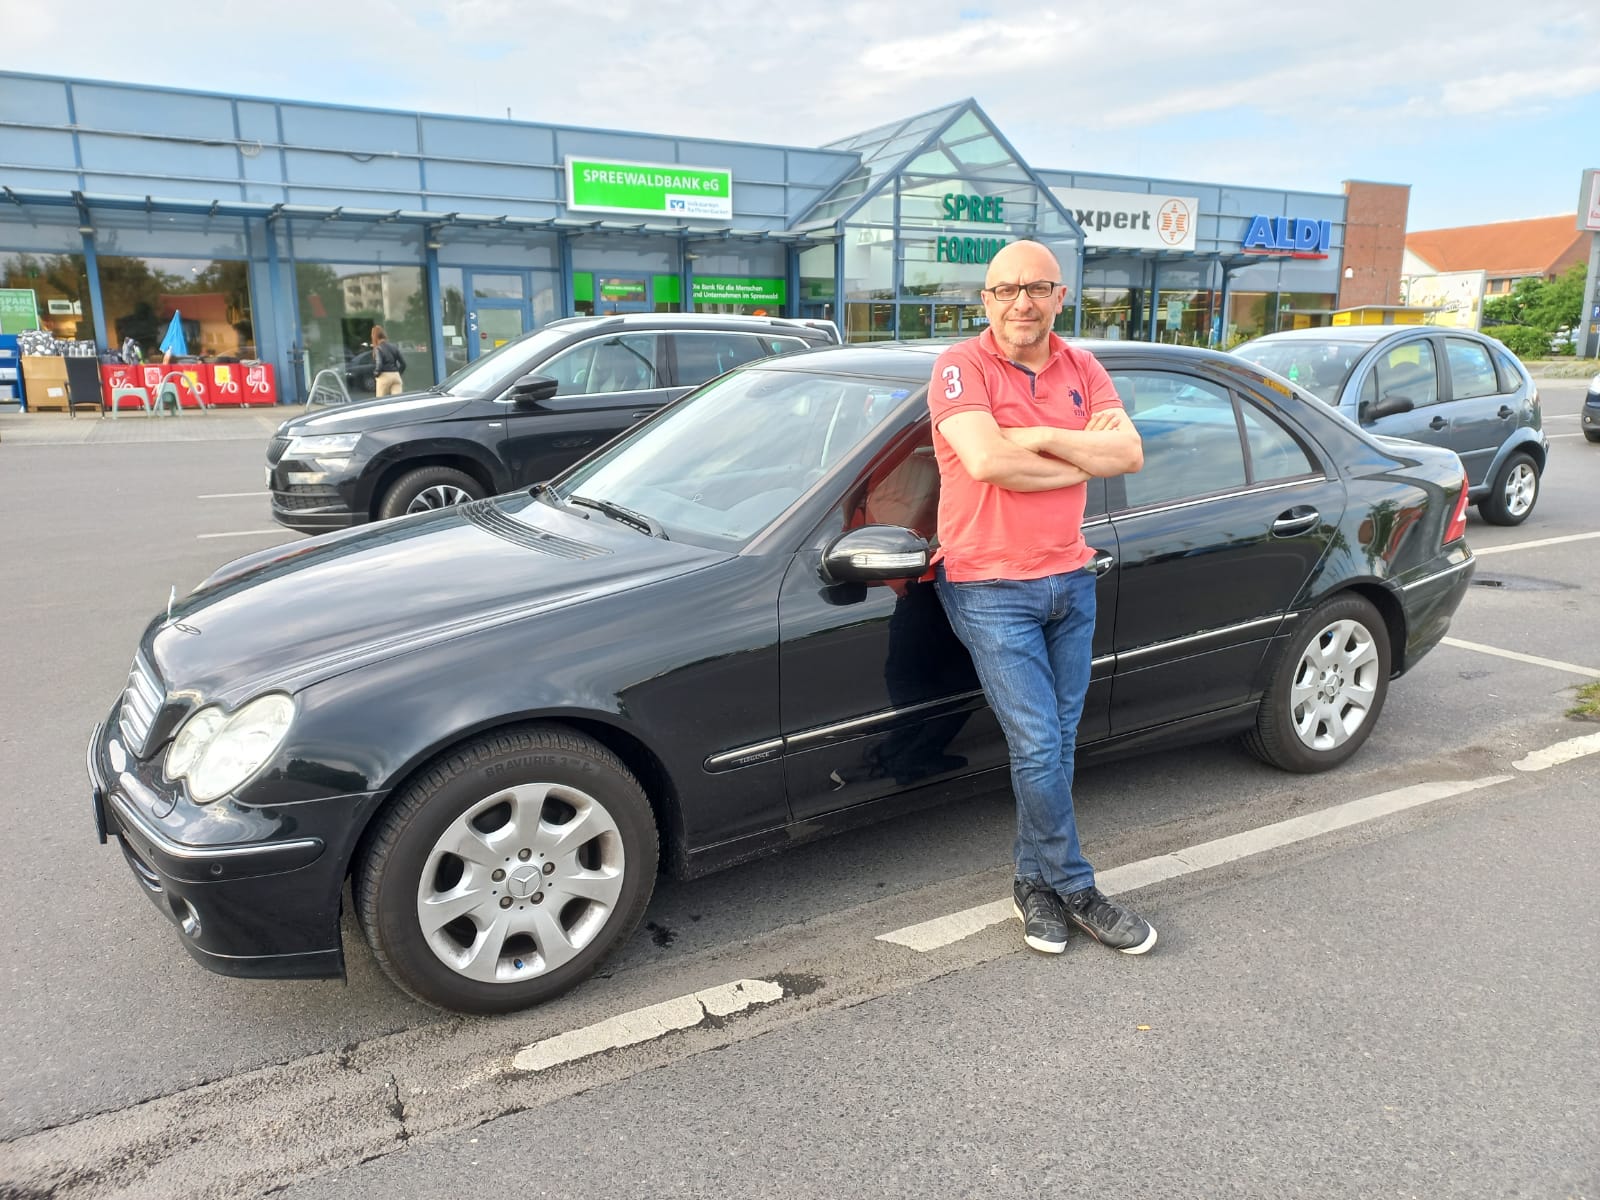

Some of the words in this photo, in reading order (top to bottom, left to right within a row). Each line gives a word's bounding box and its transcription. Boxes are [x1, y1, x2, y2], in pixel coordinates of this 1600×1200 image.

[583, 168, 700, 190] SPREEWALDBANK
[703, 178, 719, 191] eG
[943, 193, 1004, 224] SPREE
[1066, 208, 1151, 232] xpert
[1243, 214, 1332, 251] ALDI
[941, 364, 964, 400] 3
[485, 755, 555, 777] BRAVURIS
